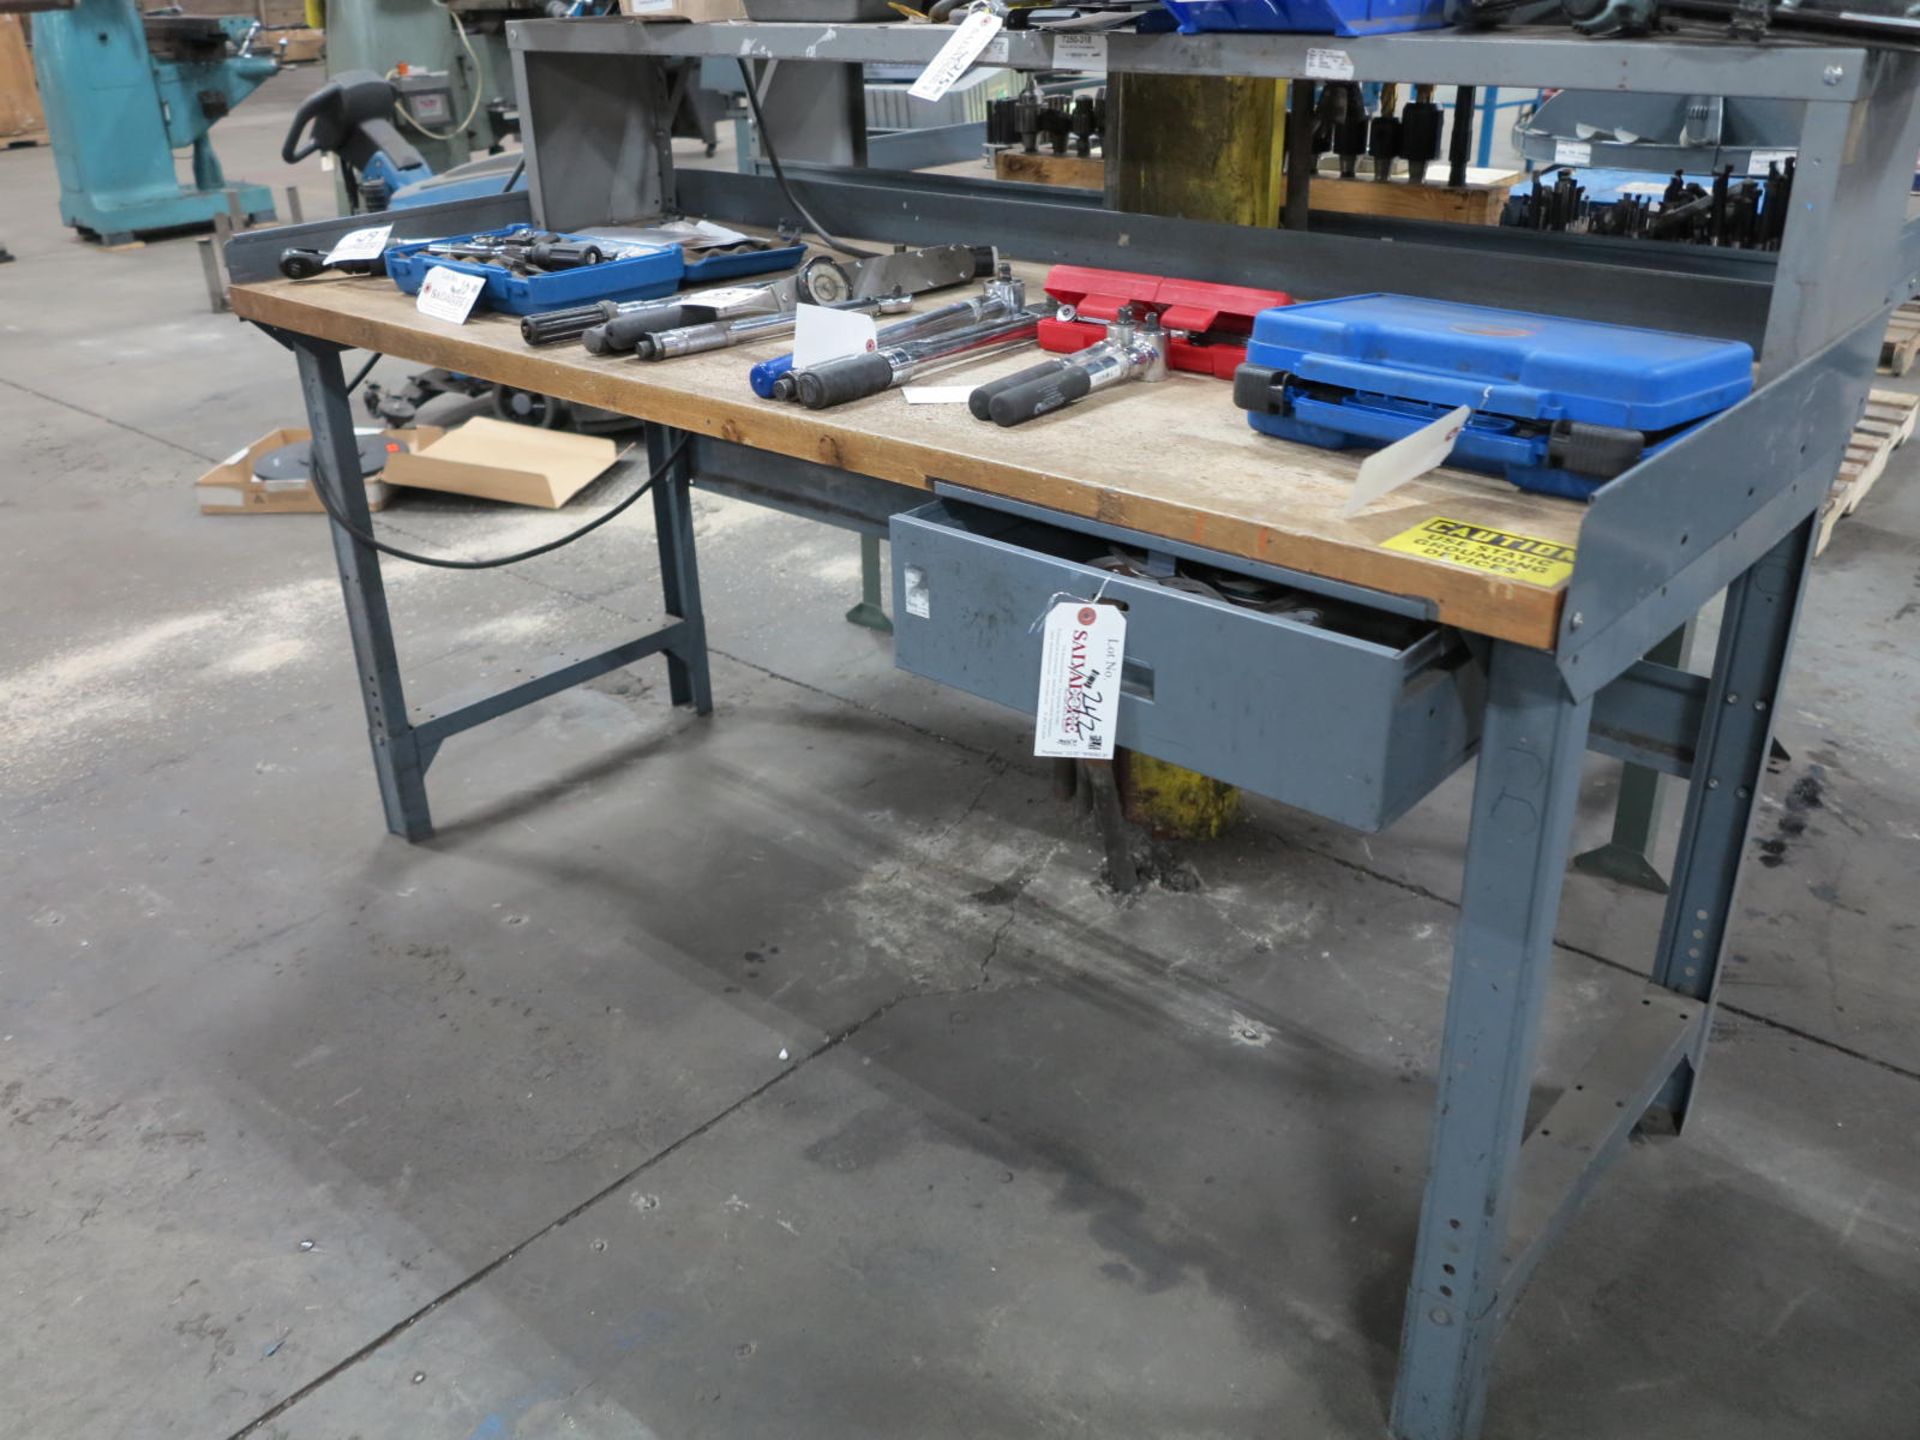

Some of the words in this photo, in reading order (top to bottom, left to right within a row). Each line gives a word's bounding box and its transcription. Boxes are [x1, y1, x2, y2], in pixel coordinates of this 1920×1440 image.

[1413, 538, 1550, 574] GROUNDING
[1424, 548, 1519, 575] DEVICES
[1427, 534, 1465, 547] USE
[1474, 544, 1555, 567] STATIC
[1106, 639, 1119, 658] Lot
[1104, 660, 1117, 681] No.
[1074, 691, 1103, 741] 242
